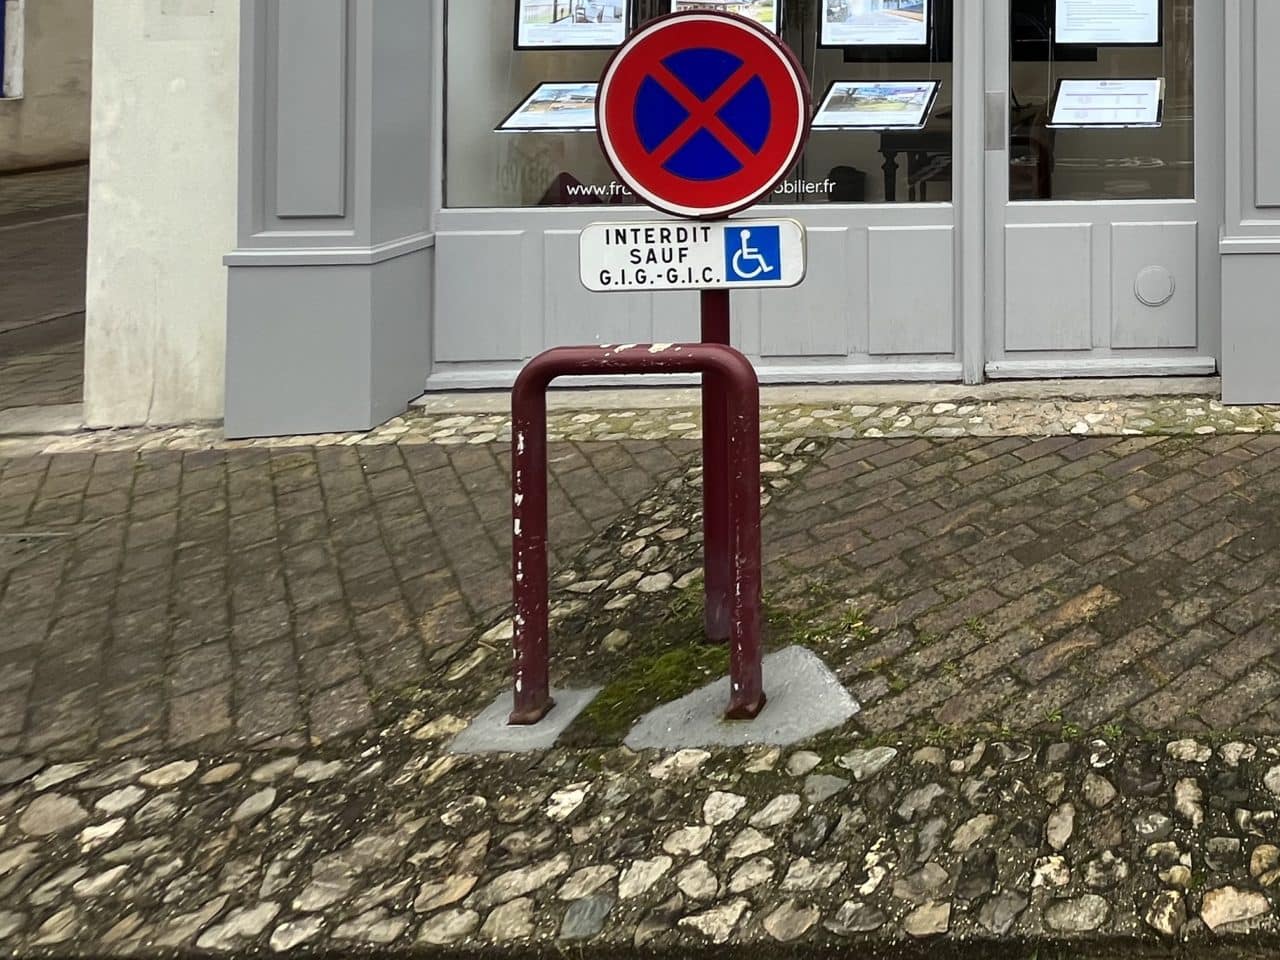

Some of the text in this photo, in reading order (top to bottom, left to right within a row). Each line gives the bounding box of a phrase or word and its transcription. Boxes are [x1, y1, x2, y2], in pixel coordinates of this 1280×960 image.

[605, 225, 711, 245] INTERDIT
[629, 247, 689, 265] SAUF
[599, 267, 721, 286] G.I.G.-G.I.C.
